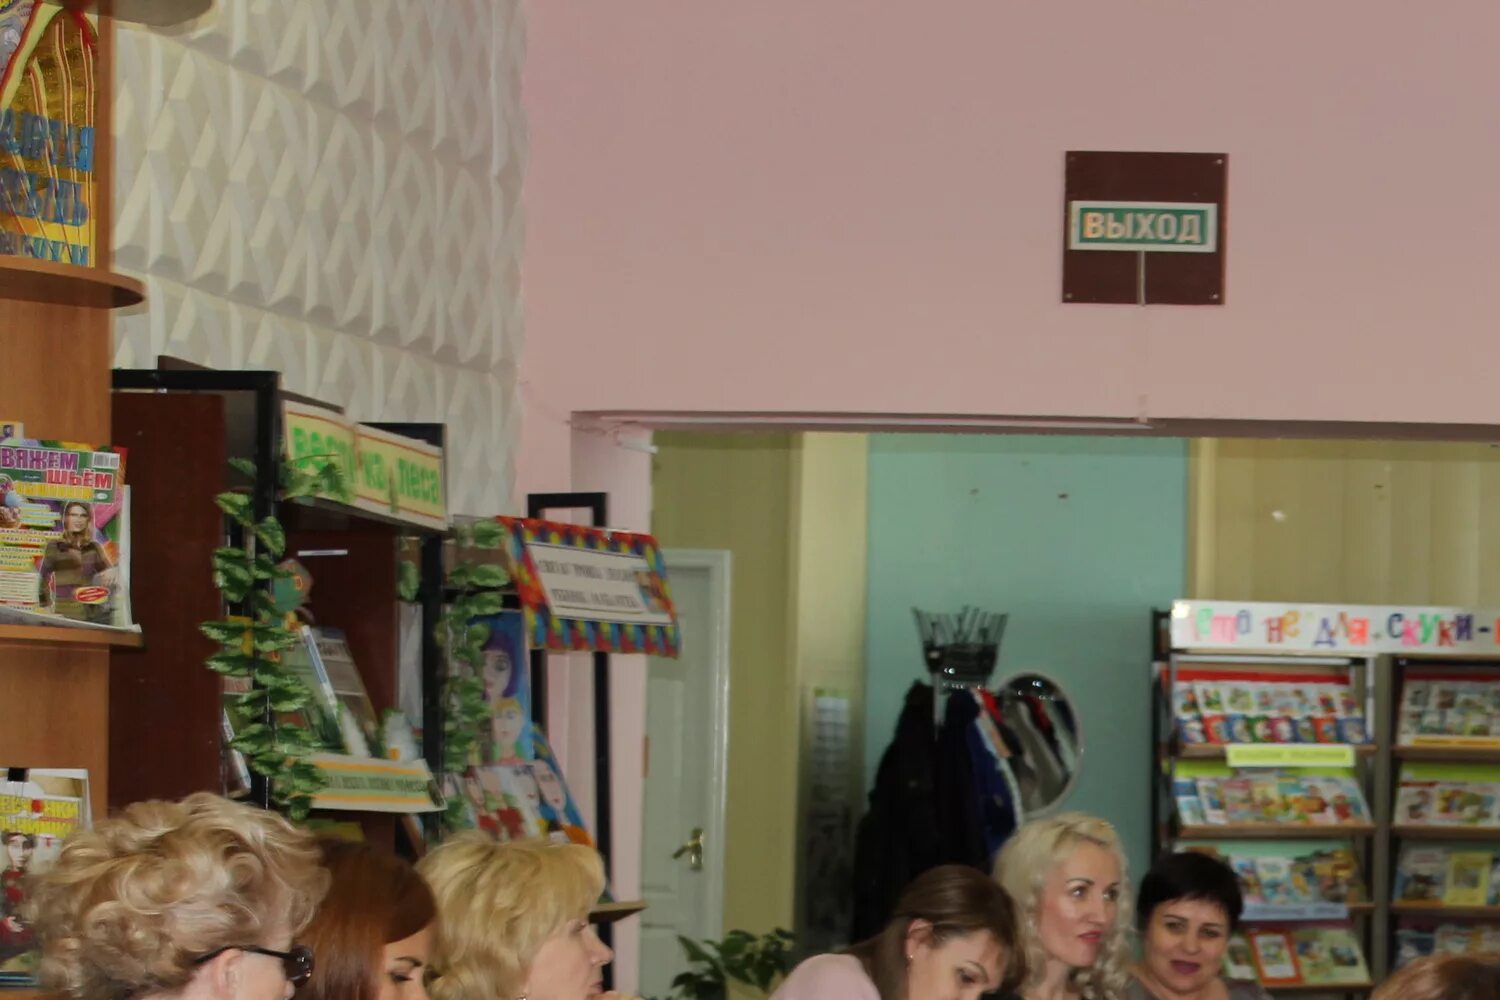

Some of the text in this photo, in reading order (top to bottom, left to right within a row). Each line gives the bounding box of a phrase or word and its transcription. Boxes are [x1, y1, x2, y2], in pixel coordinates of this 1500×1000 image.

[1084, 213, 1201, 242] ВЫХОД
[0, 446, 79, 472] ВЯЖЕМ
[46, 468, 113, 491] ШЬЁМ
